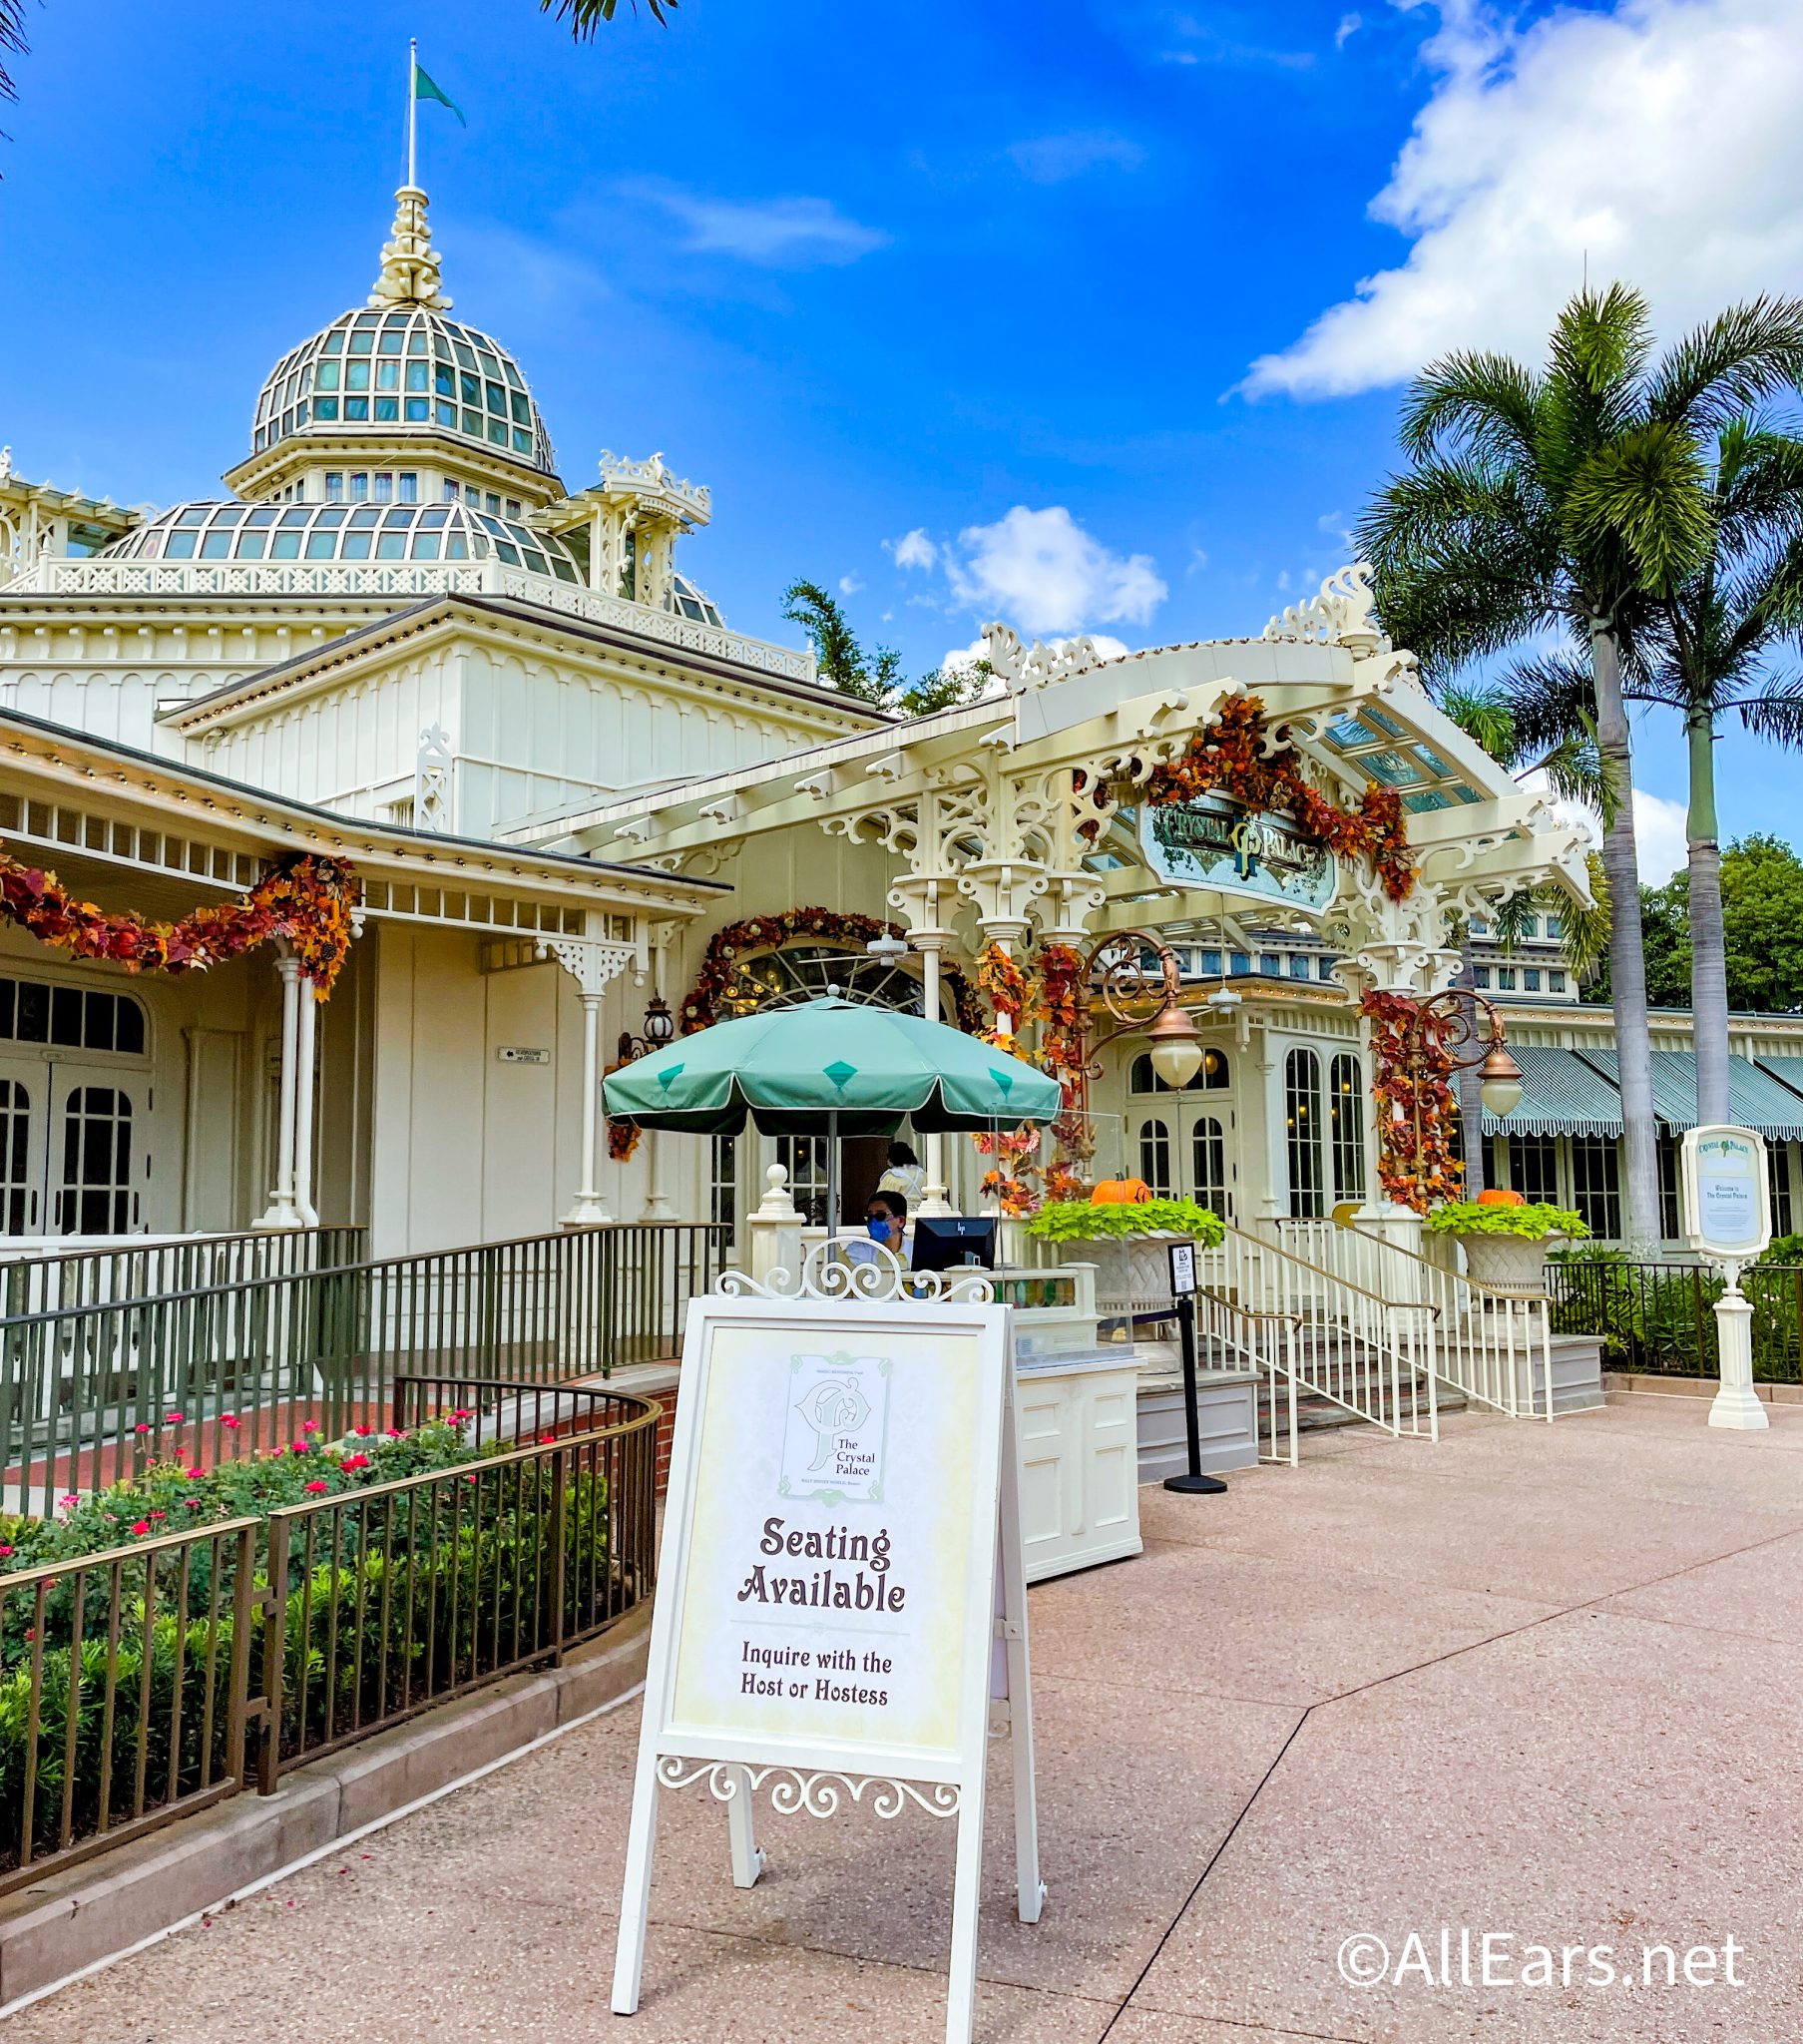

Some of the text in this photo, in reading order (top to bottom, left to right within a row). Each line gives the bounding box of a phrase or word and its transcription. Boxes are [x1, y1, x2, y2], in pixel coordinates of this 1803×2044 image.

[836, 1451, 876, 1465] Crystal
[838, 1438, 858, 1450] The
[836, 1463, 870, 1476] Palace
[759, 1517, 891, 1573] Seating
[736, 1564, 906, 1613] Available
[741, 1641, 892, 1674] Inquire with the
[740, 1672, 888, 1707] Host or Hostess
